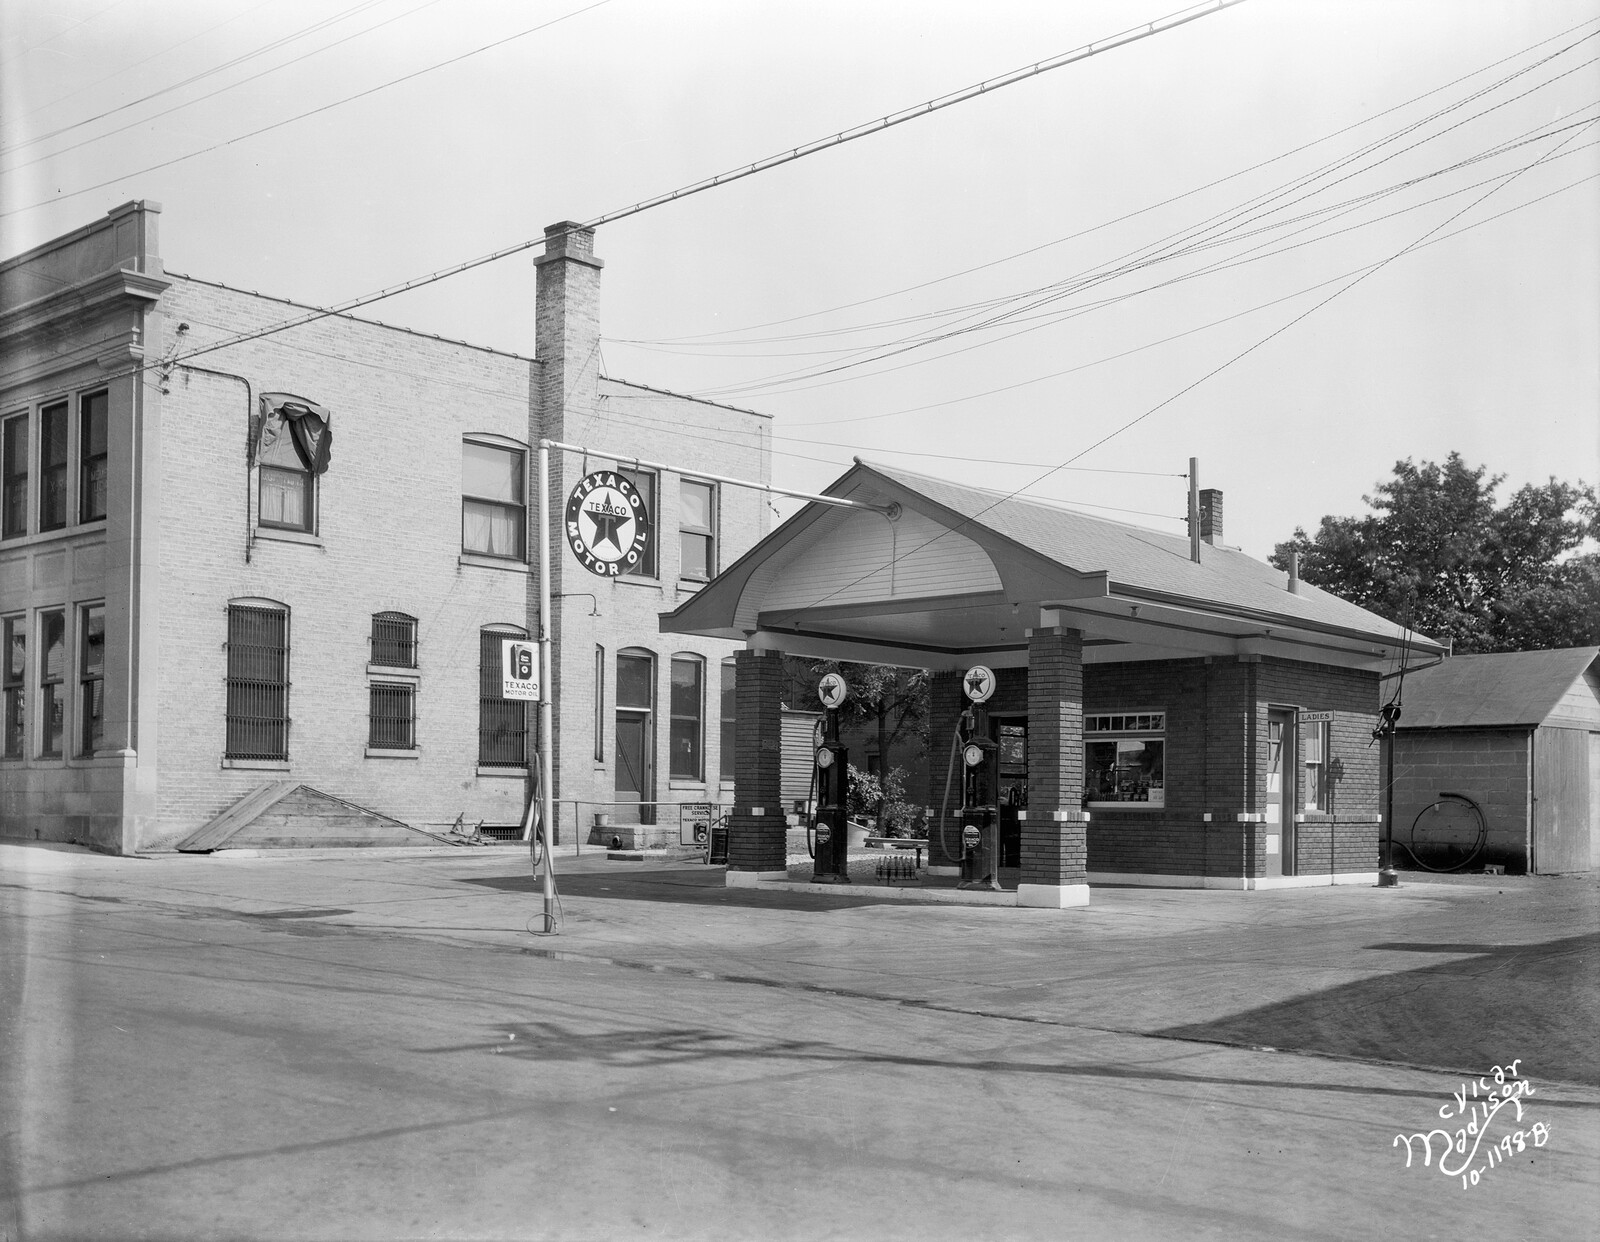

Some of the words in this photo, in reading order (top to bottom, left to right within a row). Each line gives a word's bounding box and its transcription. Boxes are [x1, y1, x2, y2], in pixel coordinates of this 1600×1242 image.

[574, 474, 640, 508] TEXACO
[589, 502, 627, 516] TEXACO
[568, 521, 620, 576] MOTOR
[627, 532, 647, 564] OIL
[505, 681, 538, 690] TEXACO
[1302, 713, 1329, 722] LADIES
